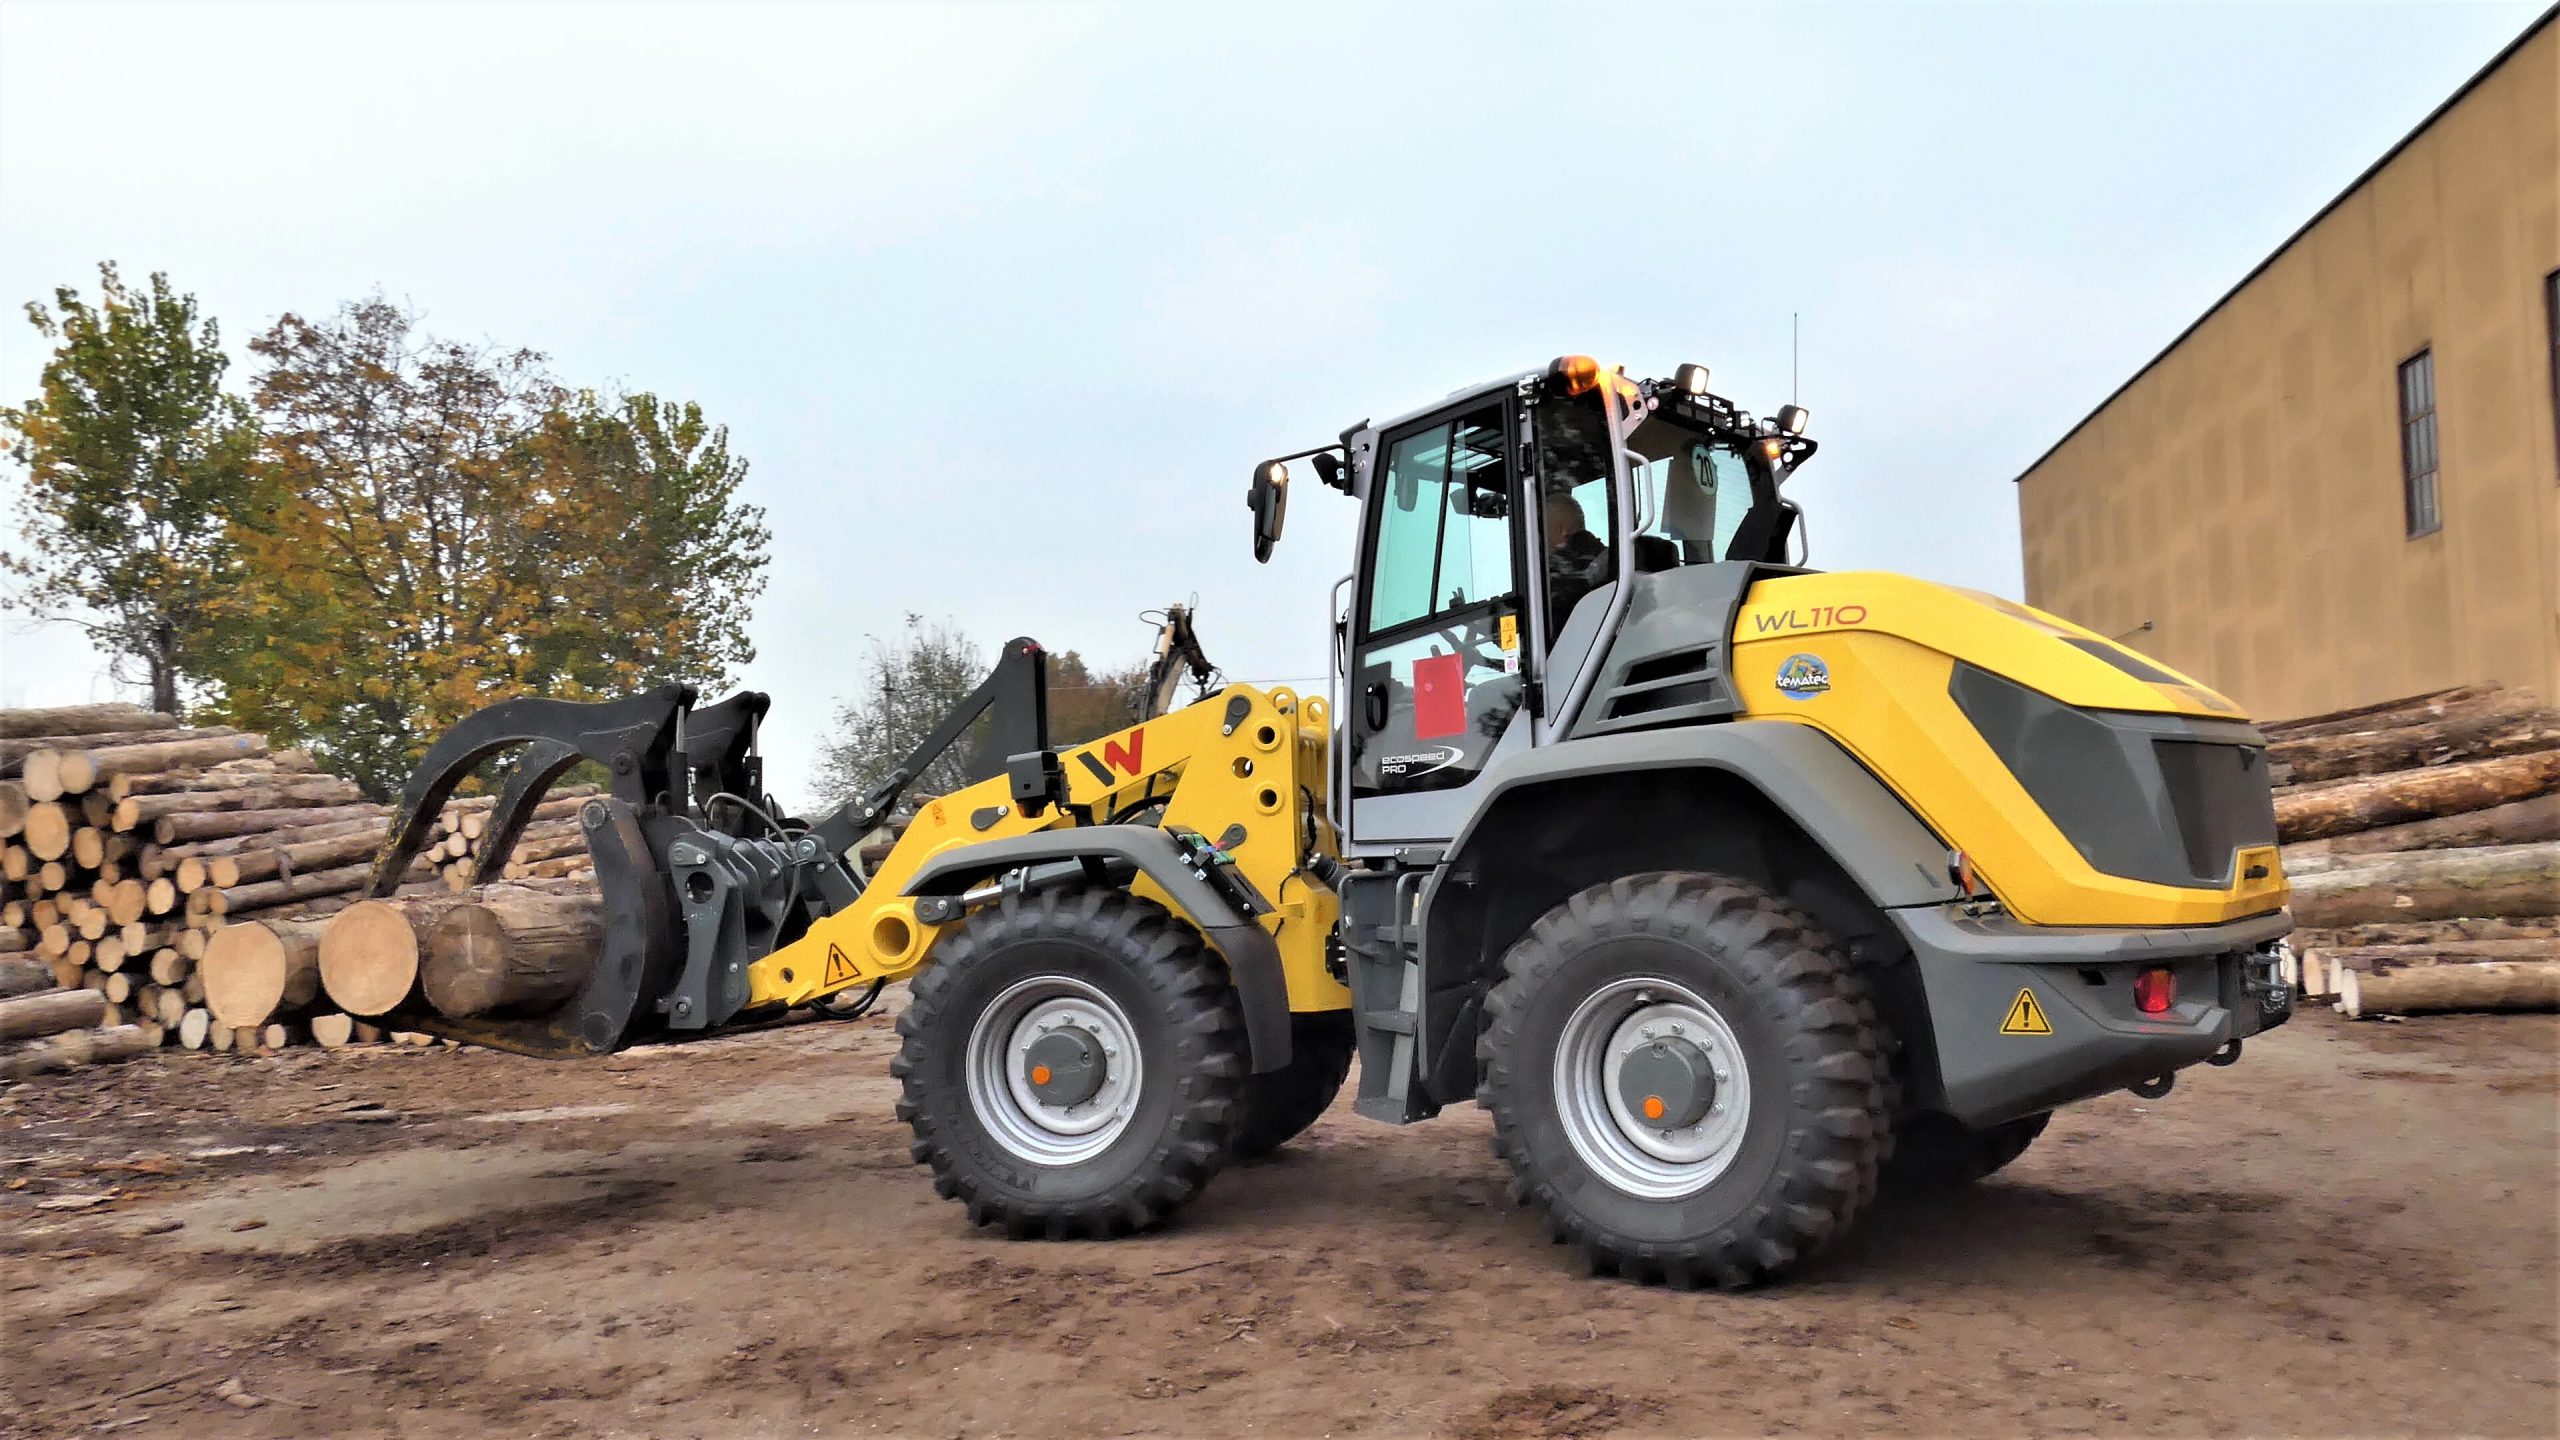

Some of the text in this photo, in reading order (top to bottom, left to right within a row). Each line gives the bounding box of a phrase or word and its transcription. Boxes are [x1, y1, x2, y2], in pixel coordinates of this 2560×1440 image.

[1696, 453, 1714, 488] 20
[1755, 605, 1867, 632] WL110
[1382, 751, 1445, 764] ecospeed
[1382, 764, 1407, 775] PRO
